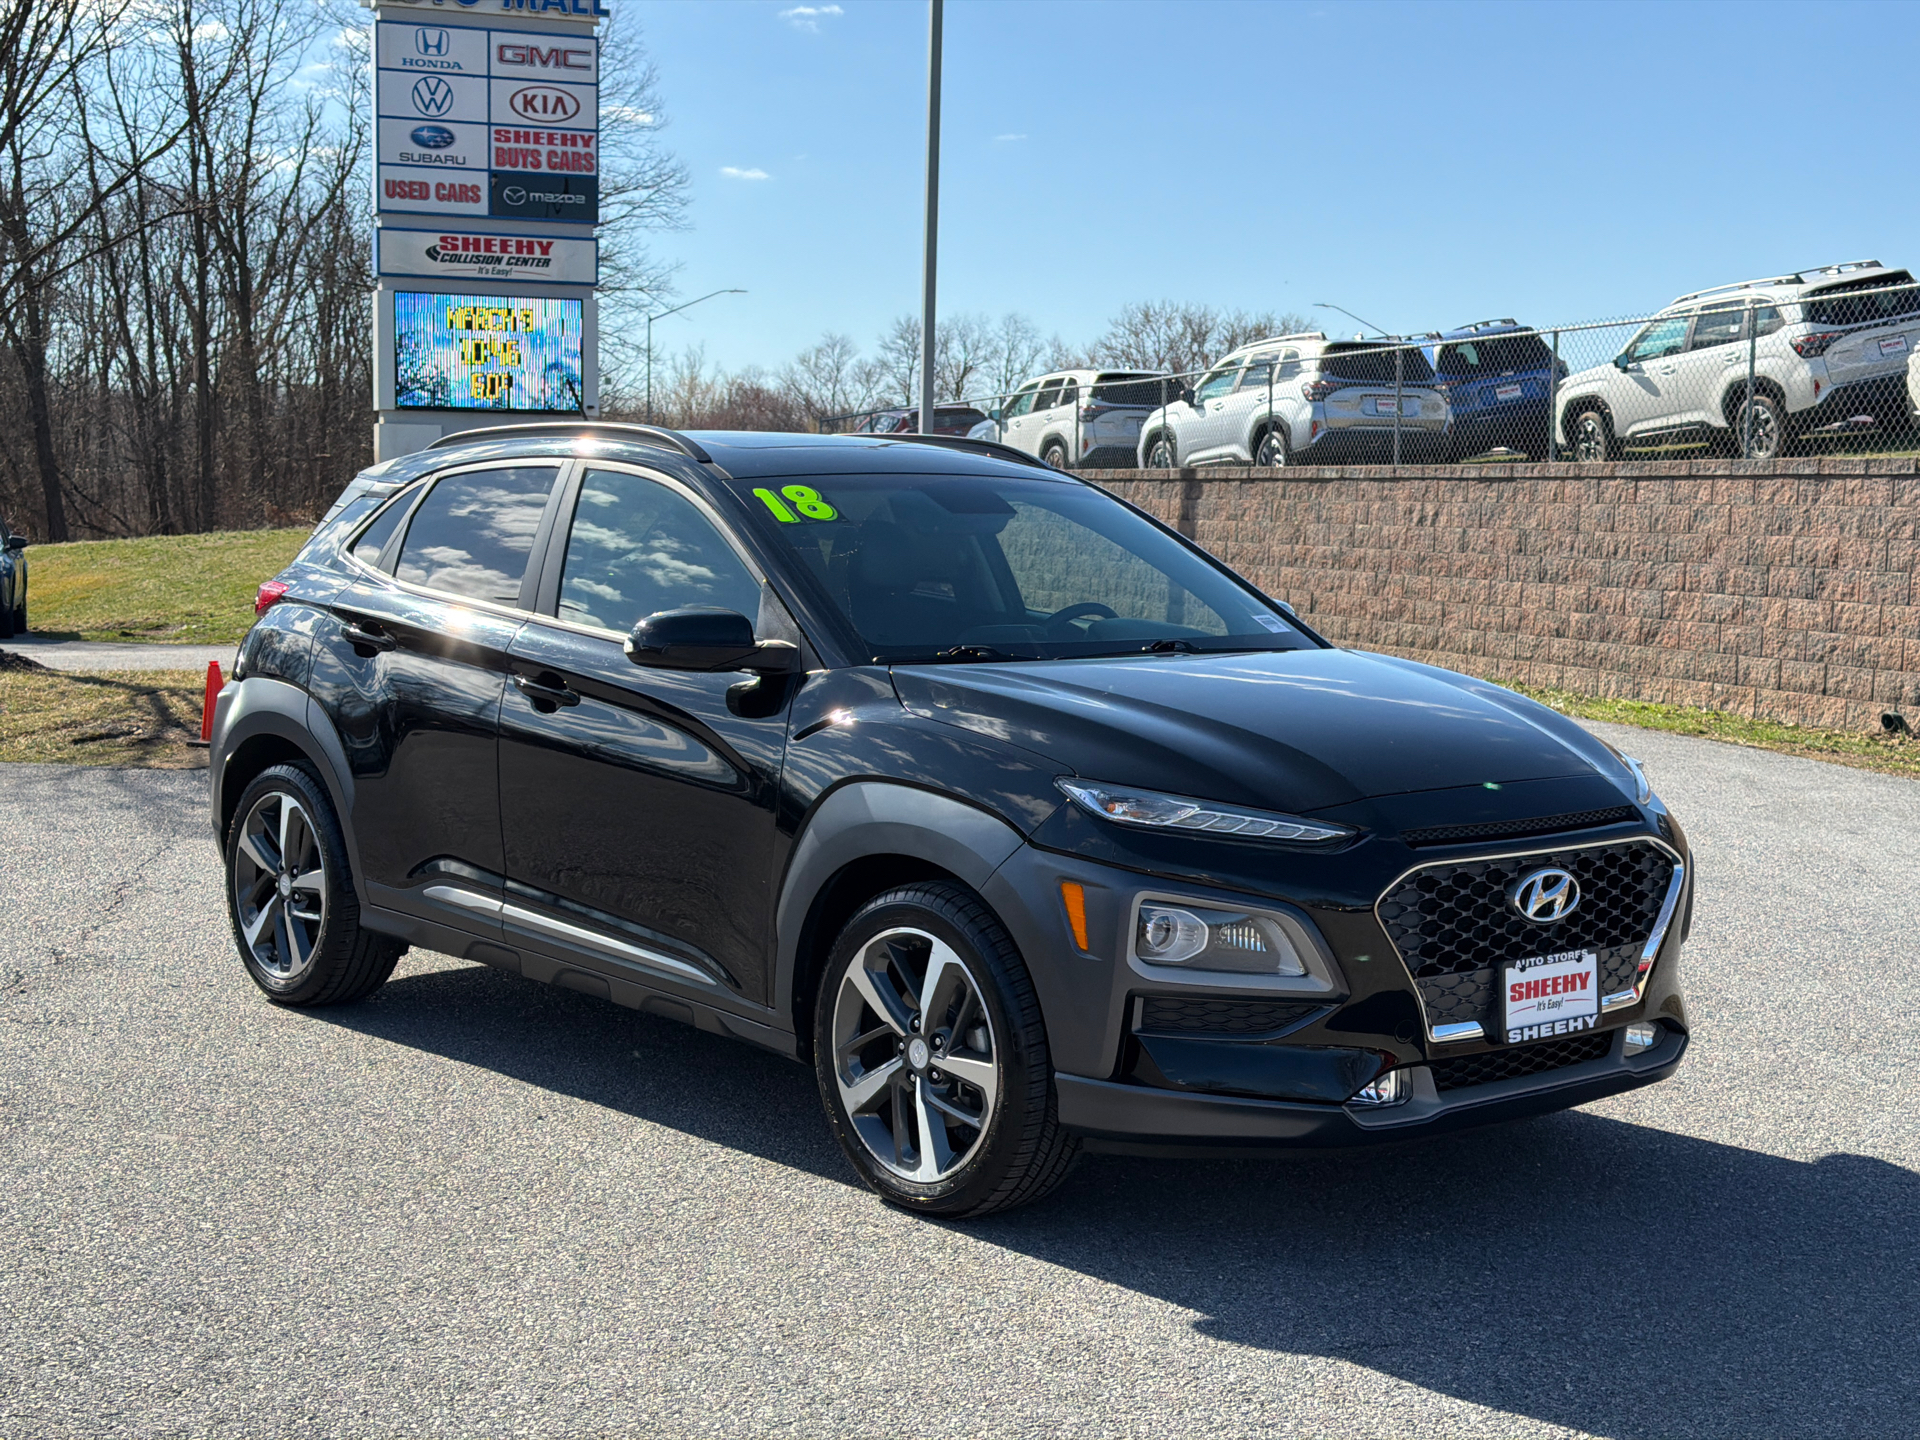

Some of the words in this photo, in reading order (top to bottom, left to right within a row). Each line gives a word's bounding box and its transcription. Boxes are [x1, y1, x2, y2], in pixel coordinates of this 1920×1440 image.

[401, 57, 464, 70] HONDA
[497, 44, 592, 71] GMC
[522, 93, 569, 116] KIA
[494, 128, 595, 149] SHEEHY
[399, 152, 467, 166] SUBARU
[495, 147, 542, 170] BUYS
[546, 151, 595, 173] CARS
[384, 179, 431, 201] USED
[434, 182, 482, 204] CARS
[529, 191, 586, 204] mazda
[439, 235, 555, 256] SHEEHY
[438, 253, 503, 266] COLLISION
[505, 256, 552, 268] CENTER
[477, 265, 491, 276] It's
[492, 267, 513, 277] Easy!
[752, 484, 838, 523] 18
[1515, 956, 1544, 969] AUTO
[1510, 971, 1591, 1002] SHEEHY
[1537, 1000, 1546, 1011] It's
[1547, 997, 1564, 1010] Easy!
[1508, 1014, 1598, 1043] SHEEHY
